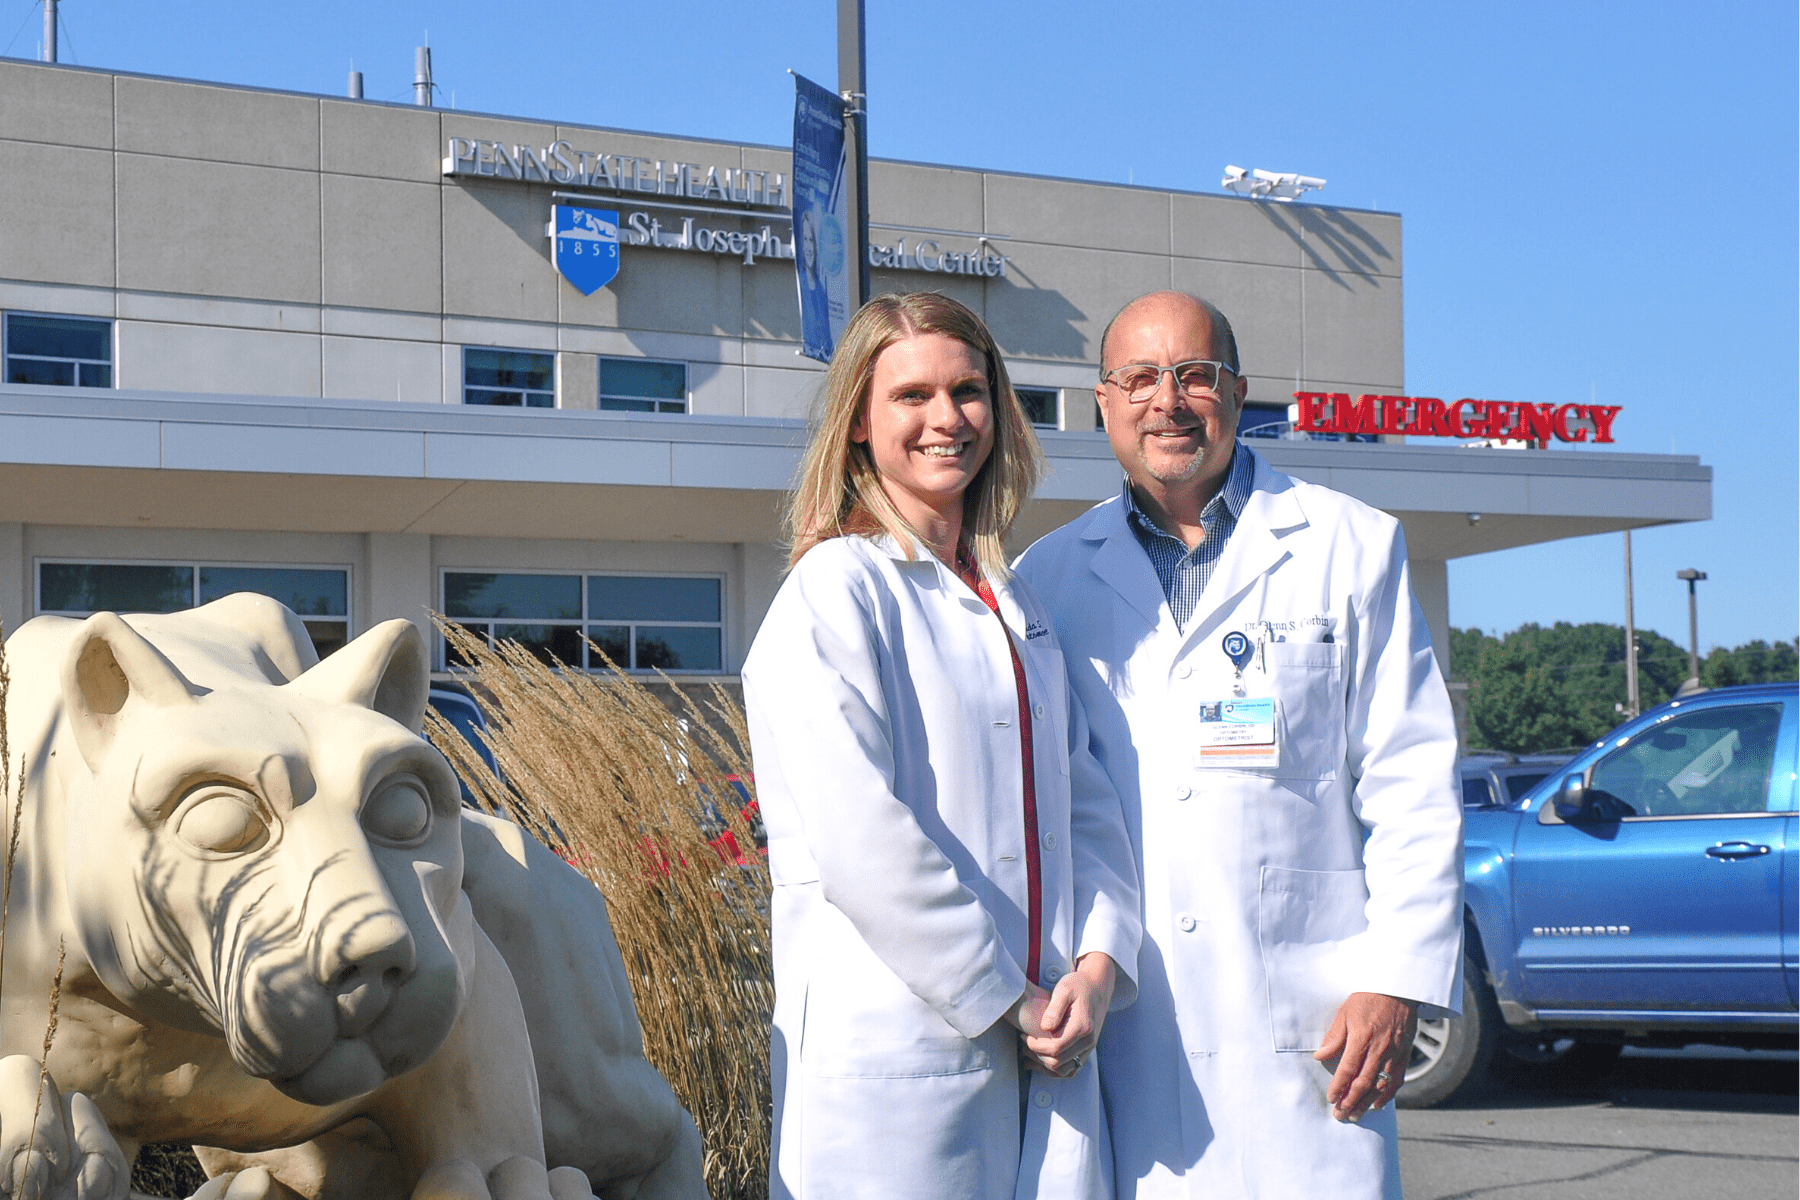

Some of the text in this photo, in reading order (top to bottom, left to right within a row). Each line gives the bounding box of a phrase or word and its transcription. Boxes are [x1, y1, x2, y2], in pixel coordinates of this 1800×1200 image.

[628, 211, 783, 266] St. Joseph
[914, 238, 1012, 277] Center
[1292, 391, 1623, 444] EMERGENCY
